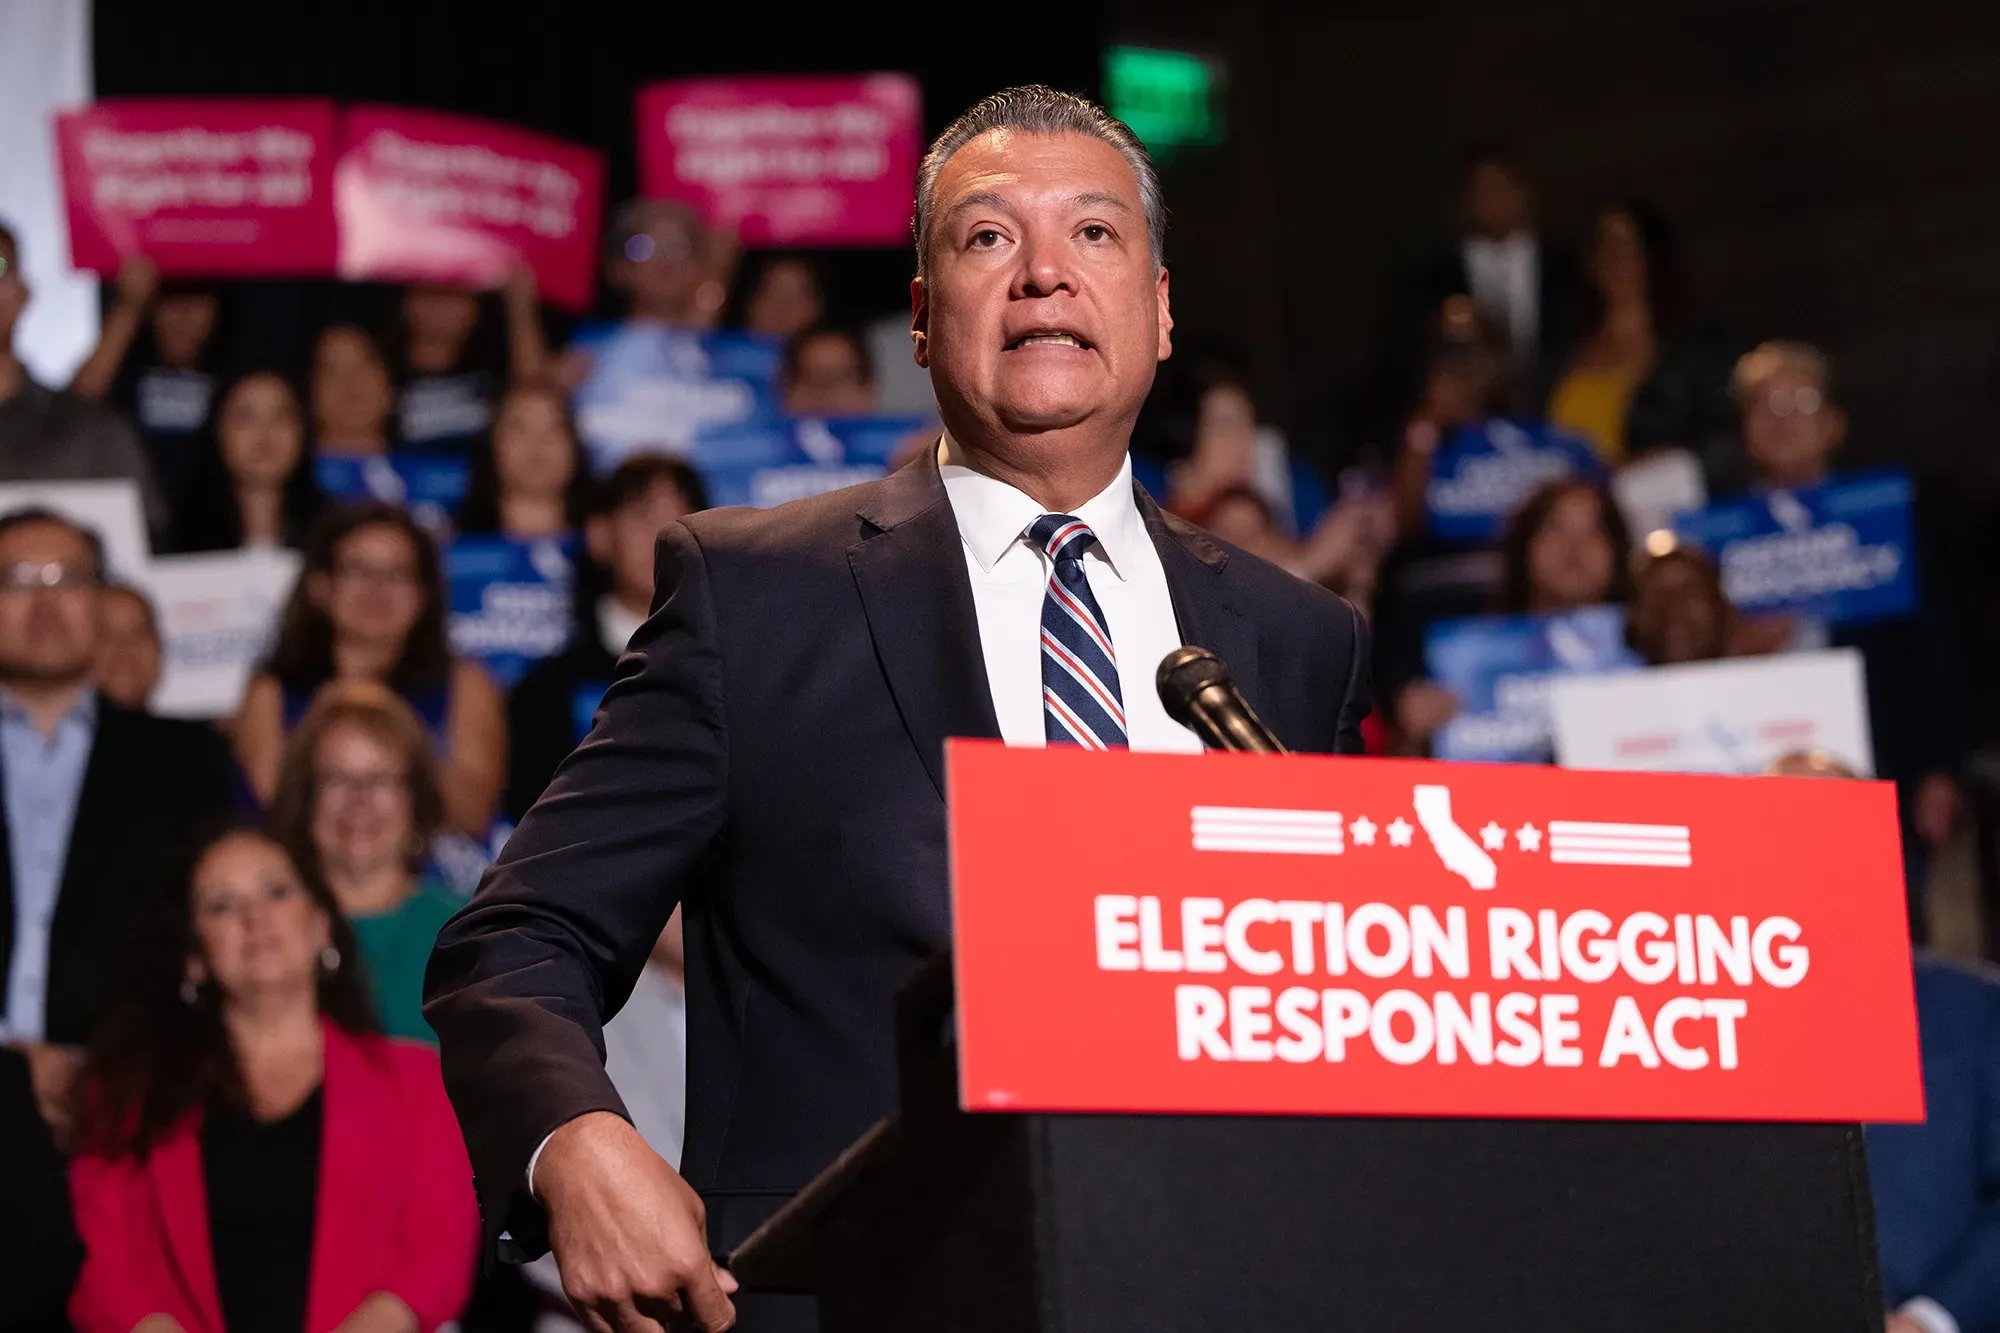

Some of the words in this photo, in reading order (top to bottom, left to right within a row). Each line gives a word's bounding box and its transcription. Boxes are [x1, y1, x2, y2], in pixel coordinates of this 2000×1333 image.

[1095, 894, 1470, 979] ELECTION
[1487, 907, 1810, 988] RIGGING
[1175, 984, 1583, 1067] RESPONSE
[1598, 996, 1748, 1070] ACT
